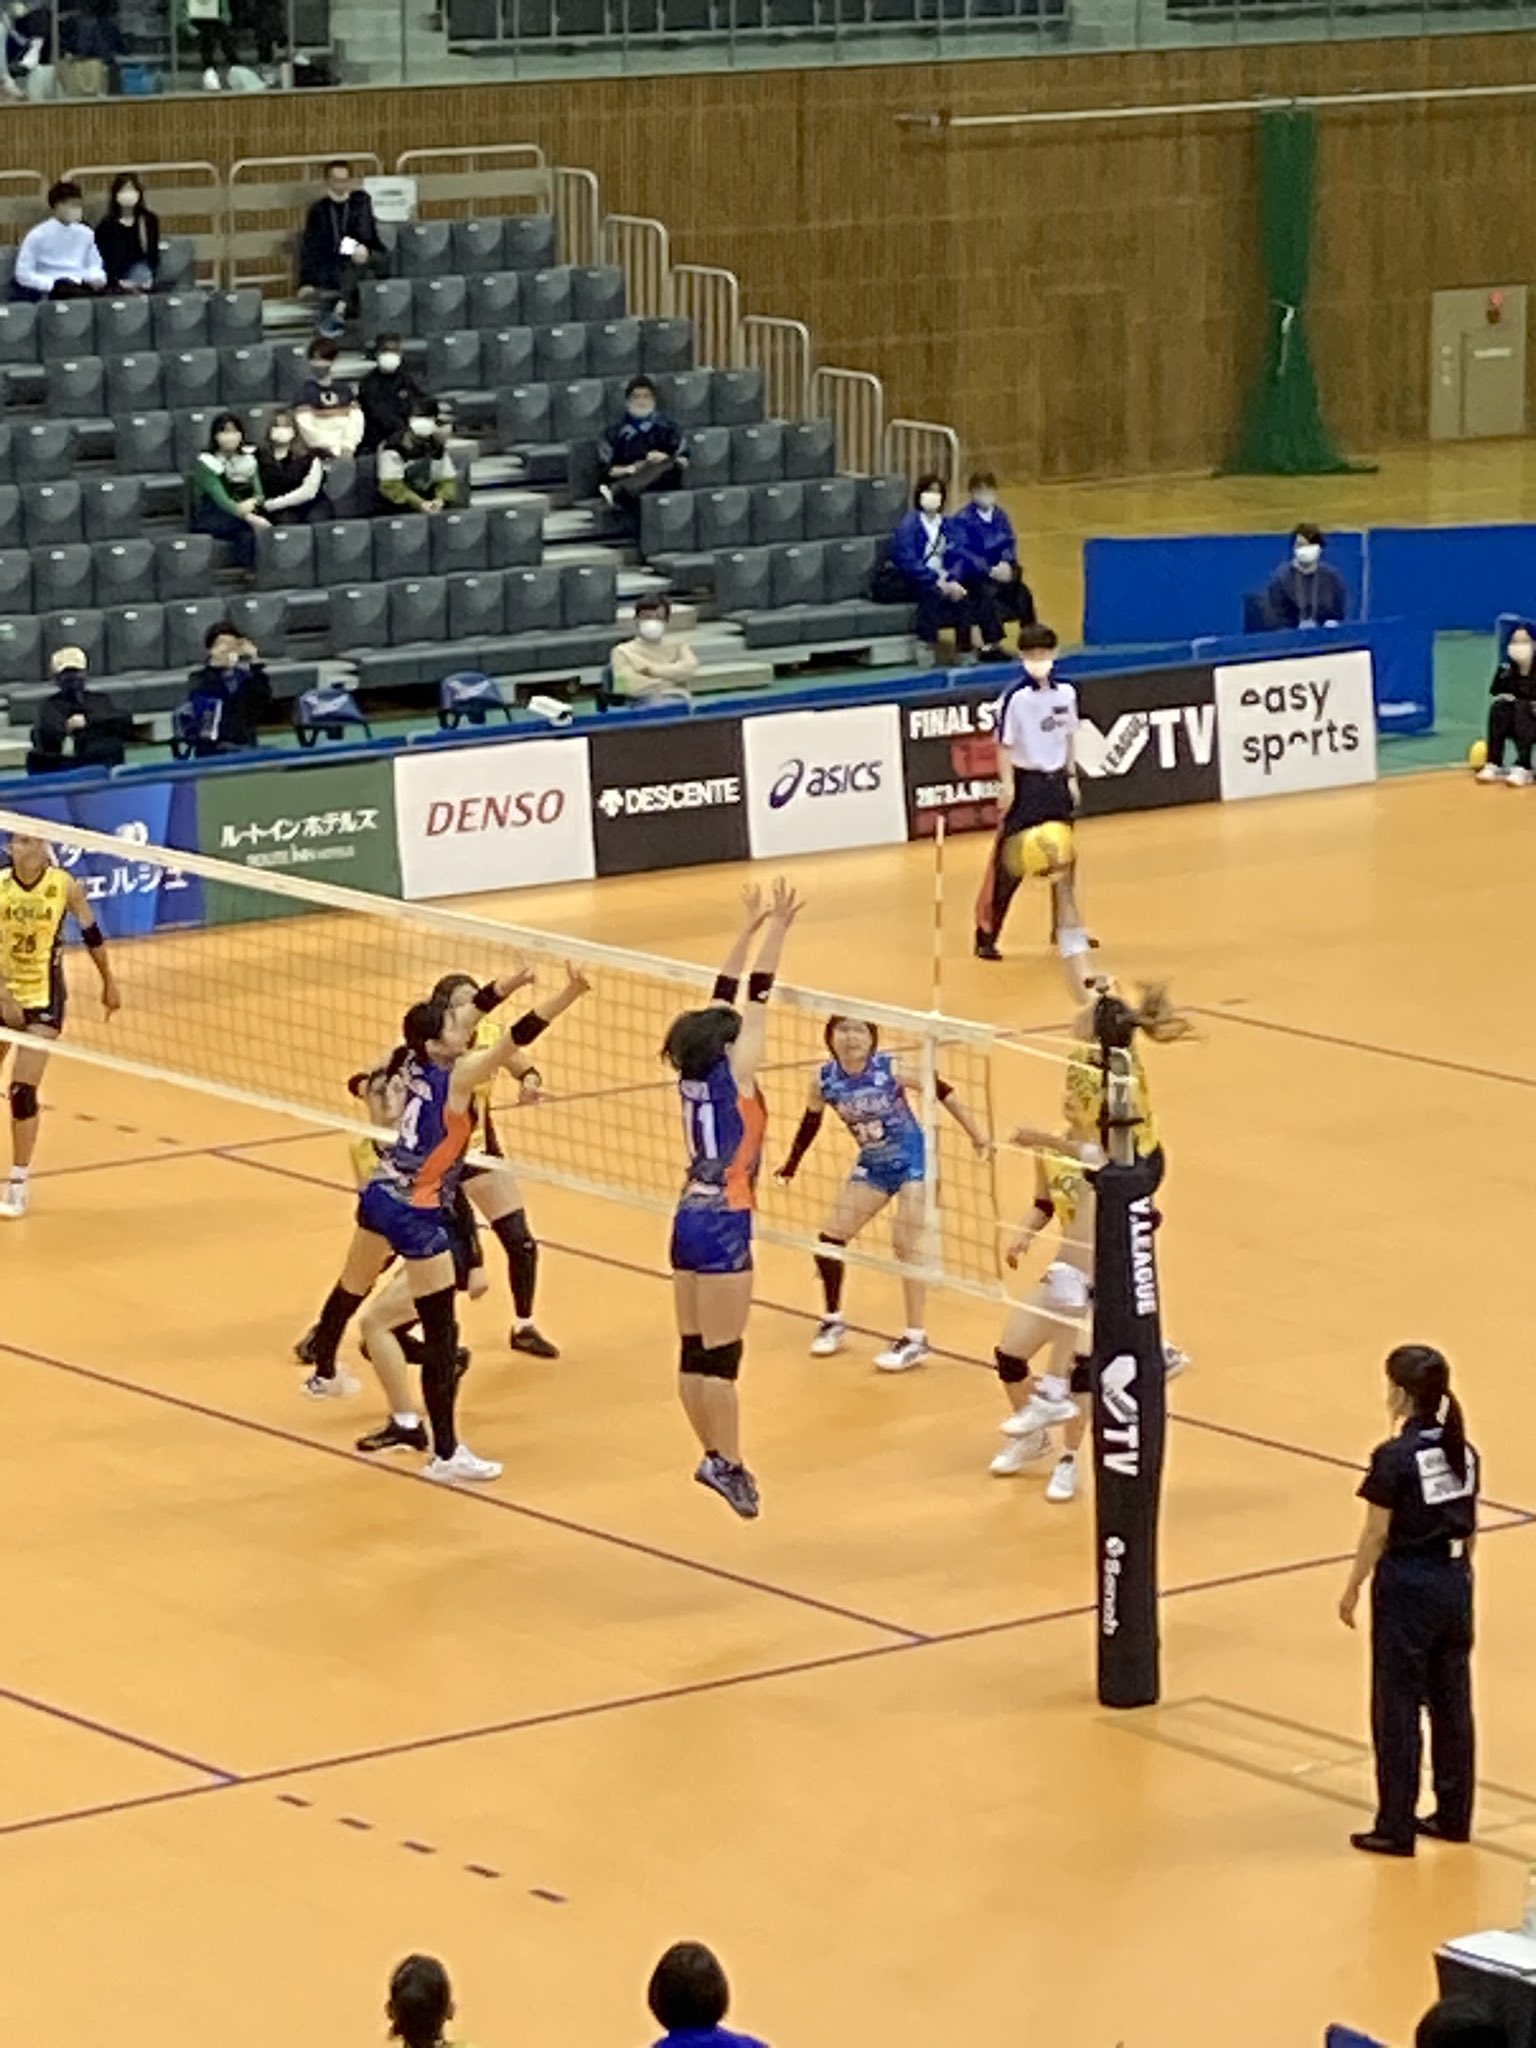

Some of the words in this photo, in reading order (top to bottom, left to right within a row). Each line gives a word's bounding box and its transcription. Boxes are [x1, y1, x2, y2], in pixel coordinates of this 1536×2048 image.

[1240, 679, 1331, 721] easy
[910, 705, 975, 739] FINAL
[625, 777, 740, 814] DESCENTE
[806, 760, 882, 797] asics
[426, 788, 565, 837] DENSO
[1128, 1196, 1157, 1316] V.LEAGUE
